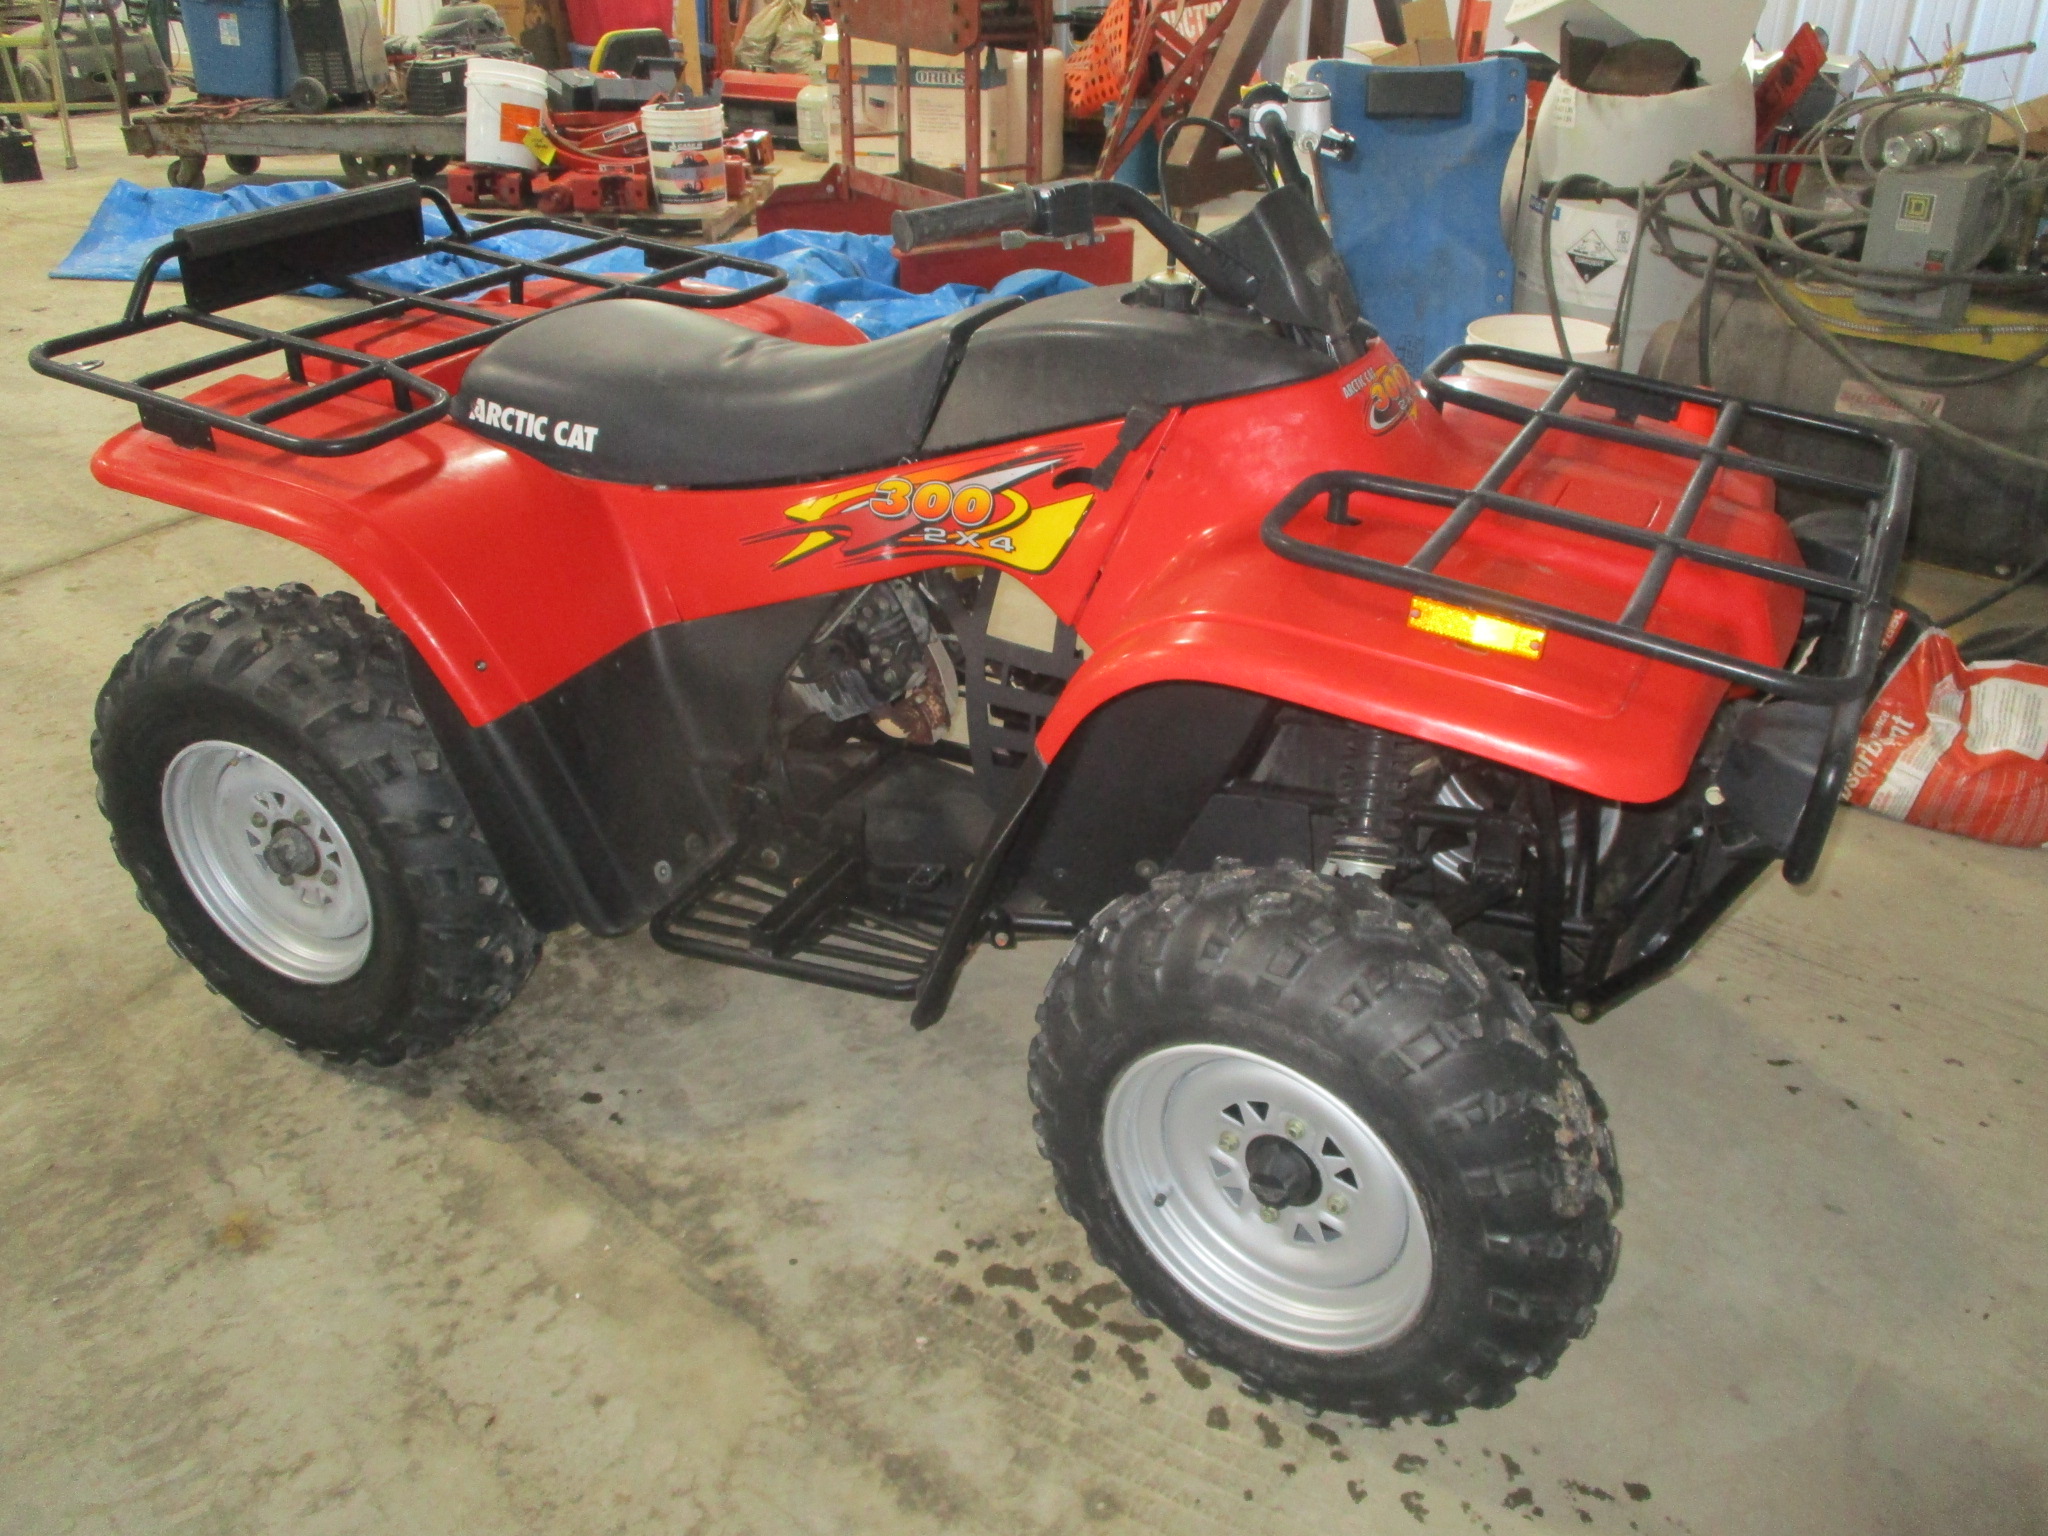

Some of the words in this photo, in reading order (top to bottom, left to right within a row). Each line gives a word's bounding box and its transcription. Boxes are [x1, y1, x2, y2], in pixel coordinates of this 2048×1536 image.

[468, 397, 549, 442] ARCTIC
[553, 420, 599, 453] CAT
[869, 477, 994, 527] 300
